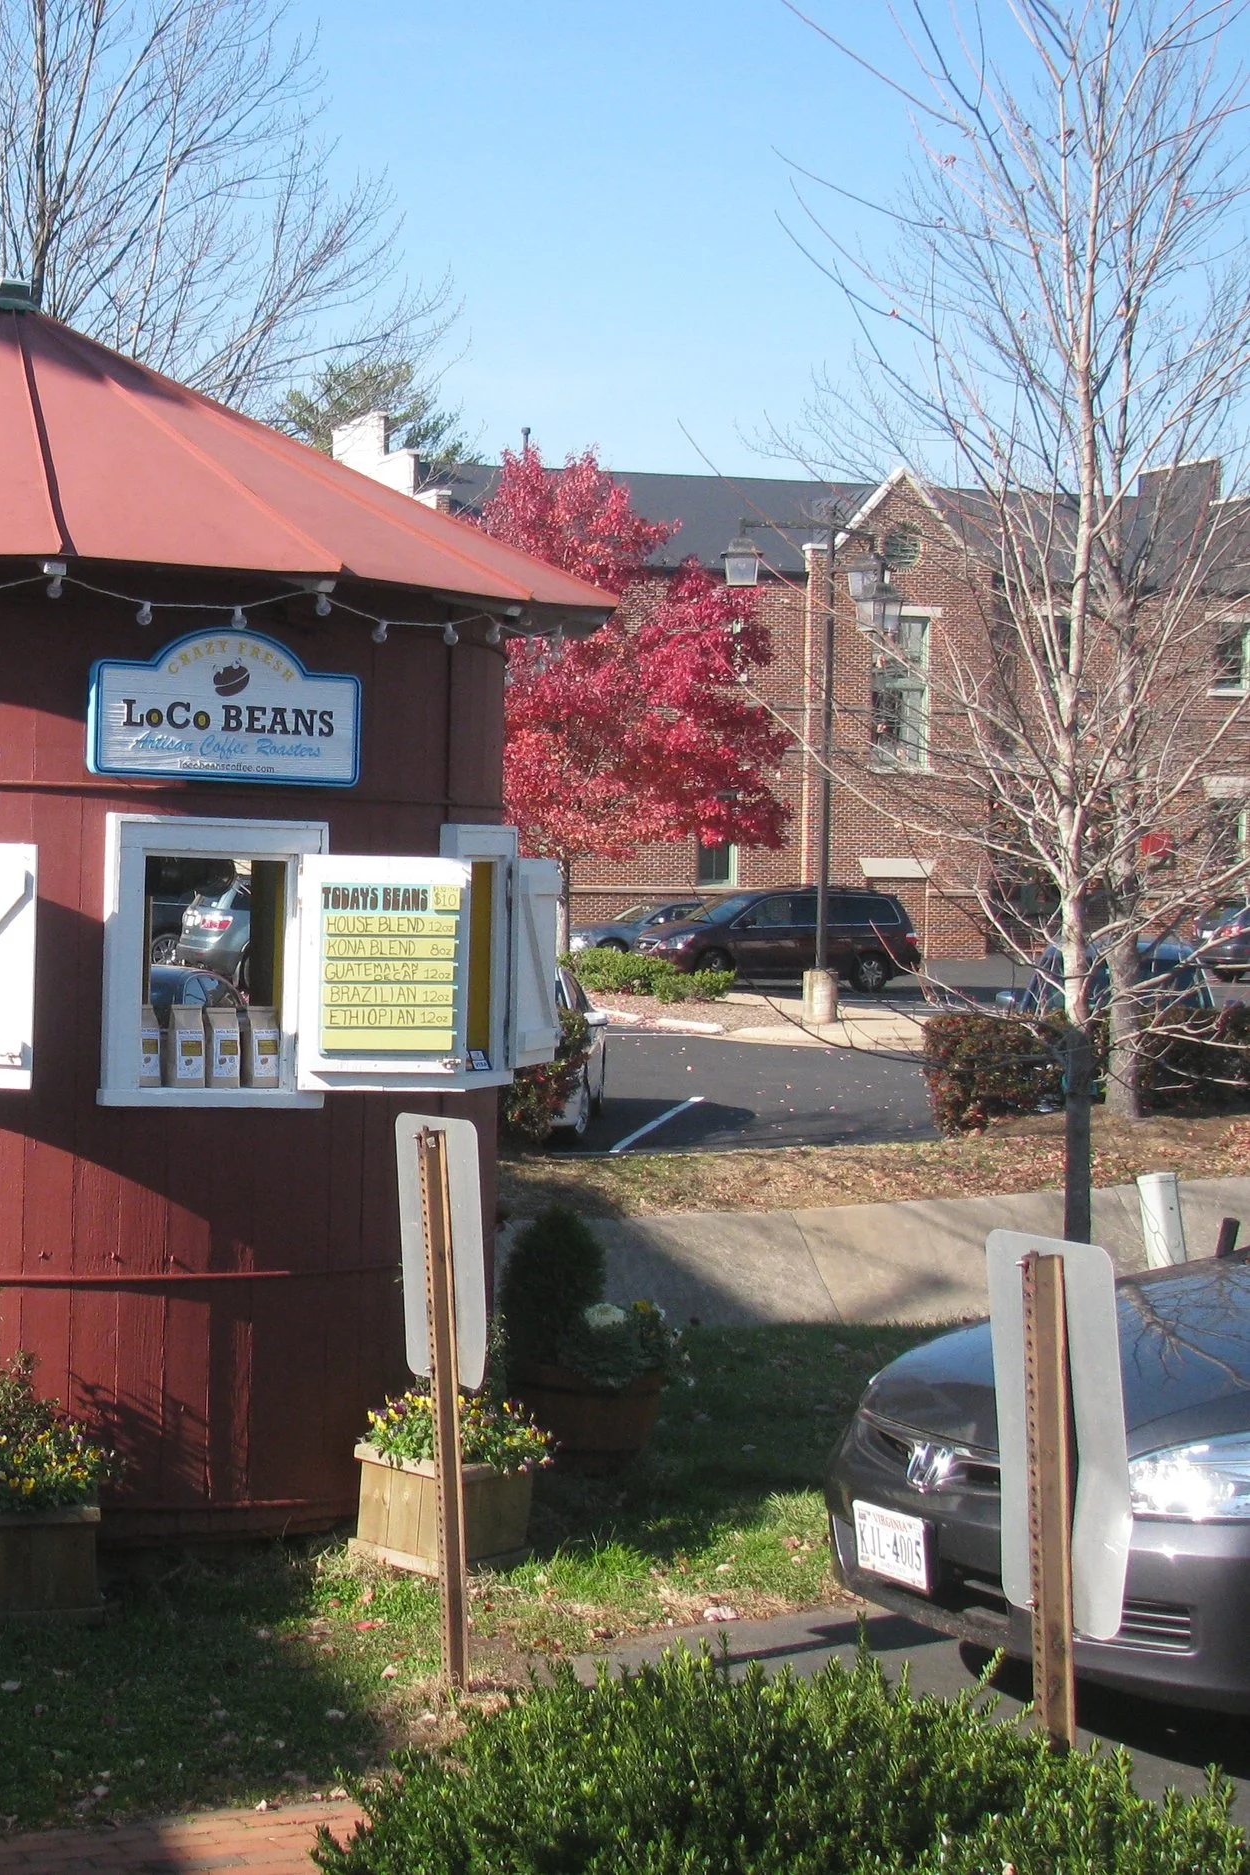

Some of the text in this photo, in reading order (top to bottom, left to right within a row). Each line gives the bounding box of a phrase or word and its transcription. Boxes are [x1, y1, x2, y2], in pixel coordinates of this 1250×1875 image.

[168, 640, 294, 682] CRAZY FRESH
[221, 704, 334, 738] BEANS
[133, 732, 321, 759] Artisan Coffee Roasters
[178, 759, 275, 774] locobeanscoffee.com
[322, 885, 428, 912] TODAY'S BEANS
[434, 892, 457, 907] $10
[326, 915, 454, 933] HOUSE BLEND 12oz
[326, 939, 452, 956] KONA BLEND 8oz
[325, 962, 451, 980] GUATEMALAN 12oz
[373, 970, 417, 981] DECAF
[330, 986, 450, 1003] BRAZILIAN 12oz
[330, 1008, 448, 1025] ETHIOPIAN 12oz
[873, 1512, 908, 1533] VIRGINIA
